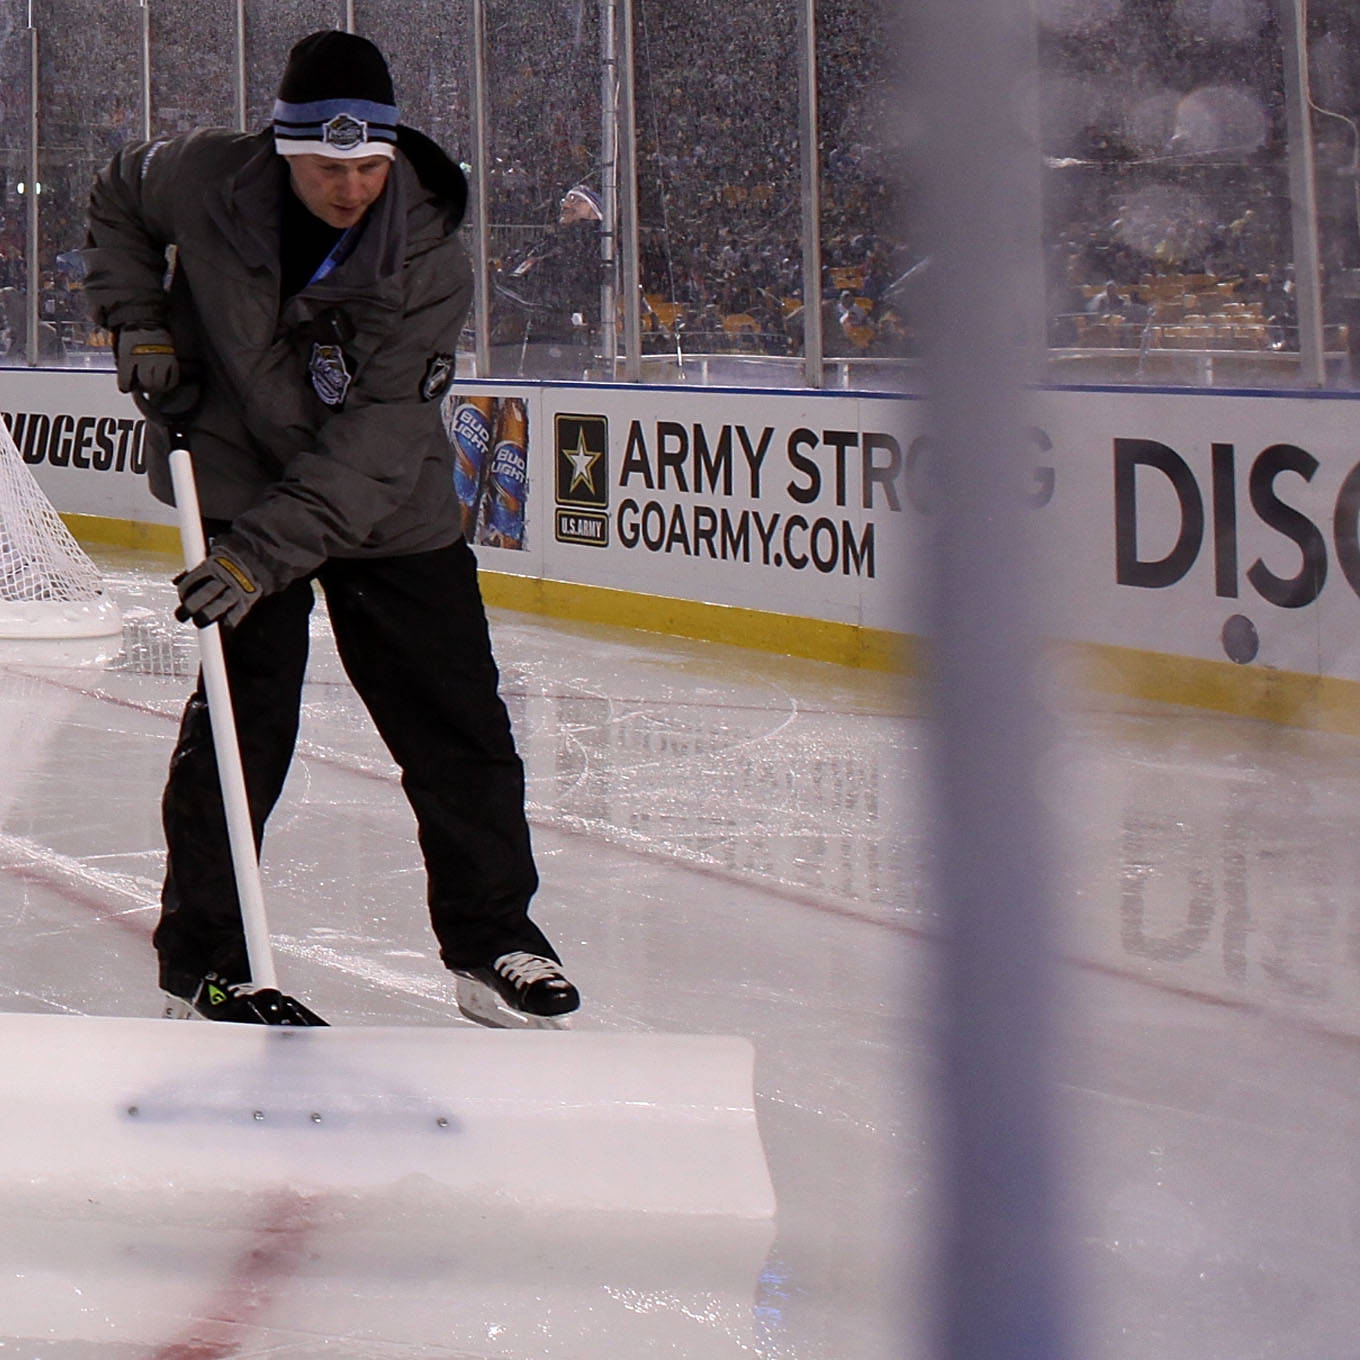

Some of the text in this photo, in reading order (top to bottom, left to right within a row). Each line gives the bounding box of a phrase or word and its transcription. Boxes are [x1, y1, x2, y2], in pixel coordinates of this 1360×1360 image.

[459, 410, 490, 442] BUD
[496, 449, 526, 470] BUD
[619, 420, 775, 499] ARMY
[617, 498, 876, 579] GOARMY.COM
